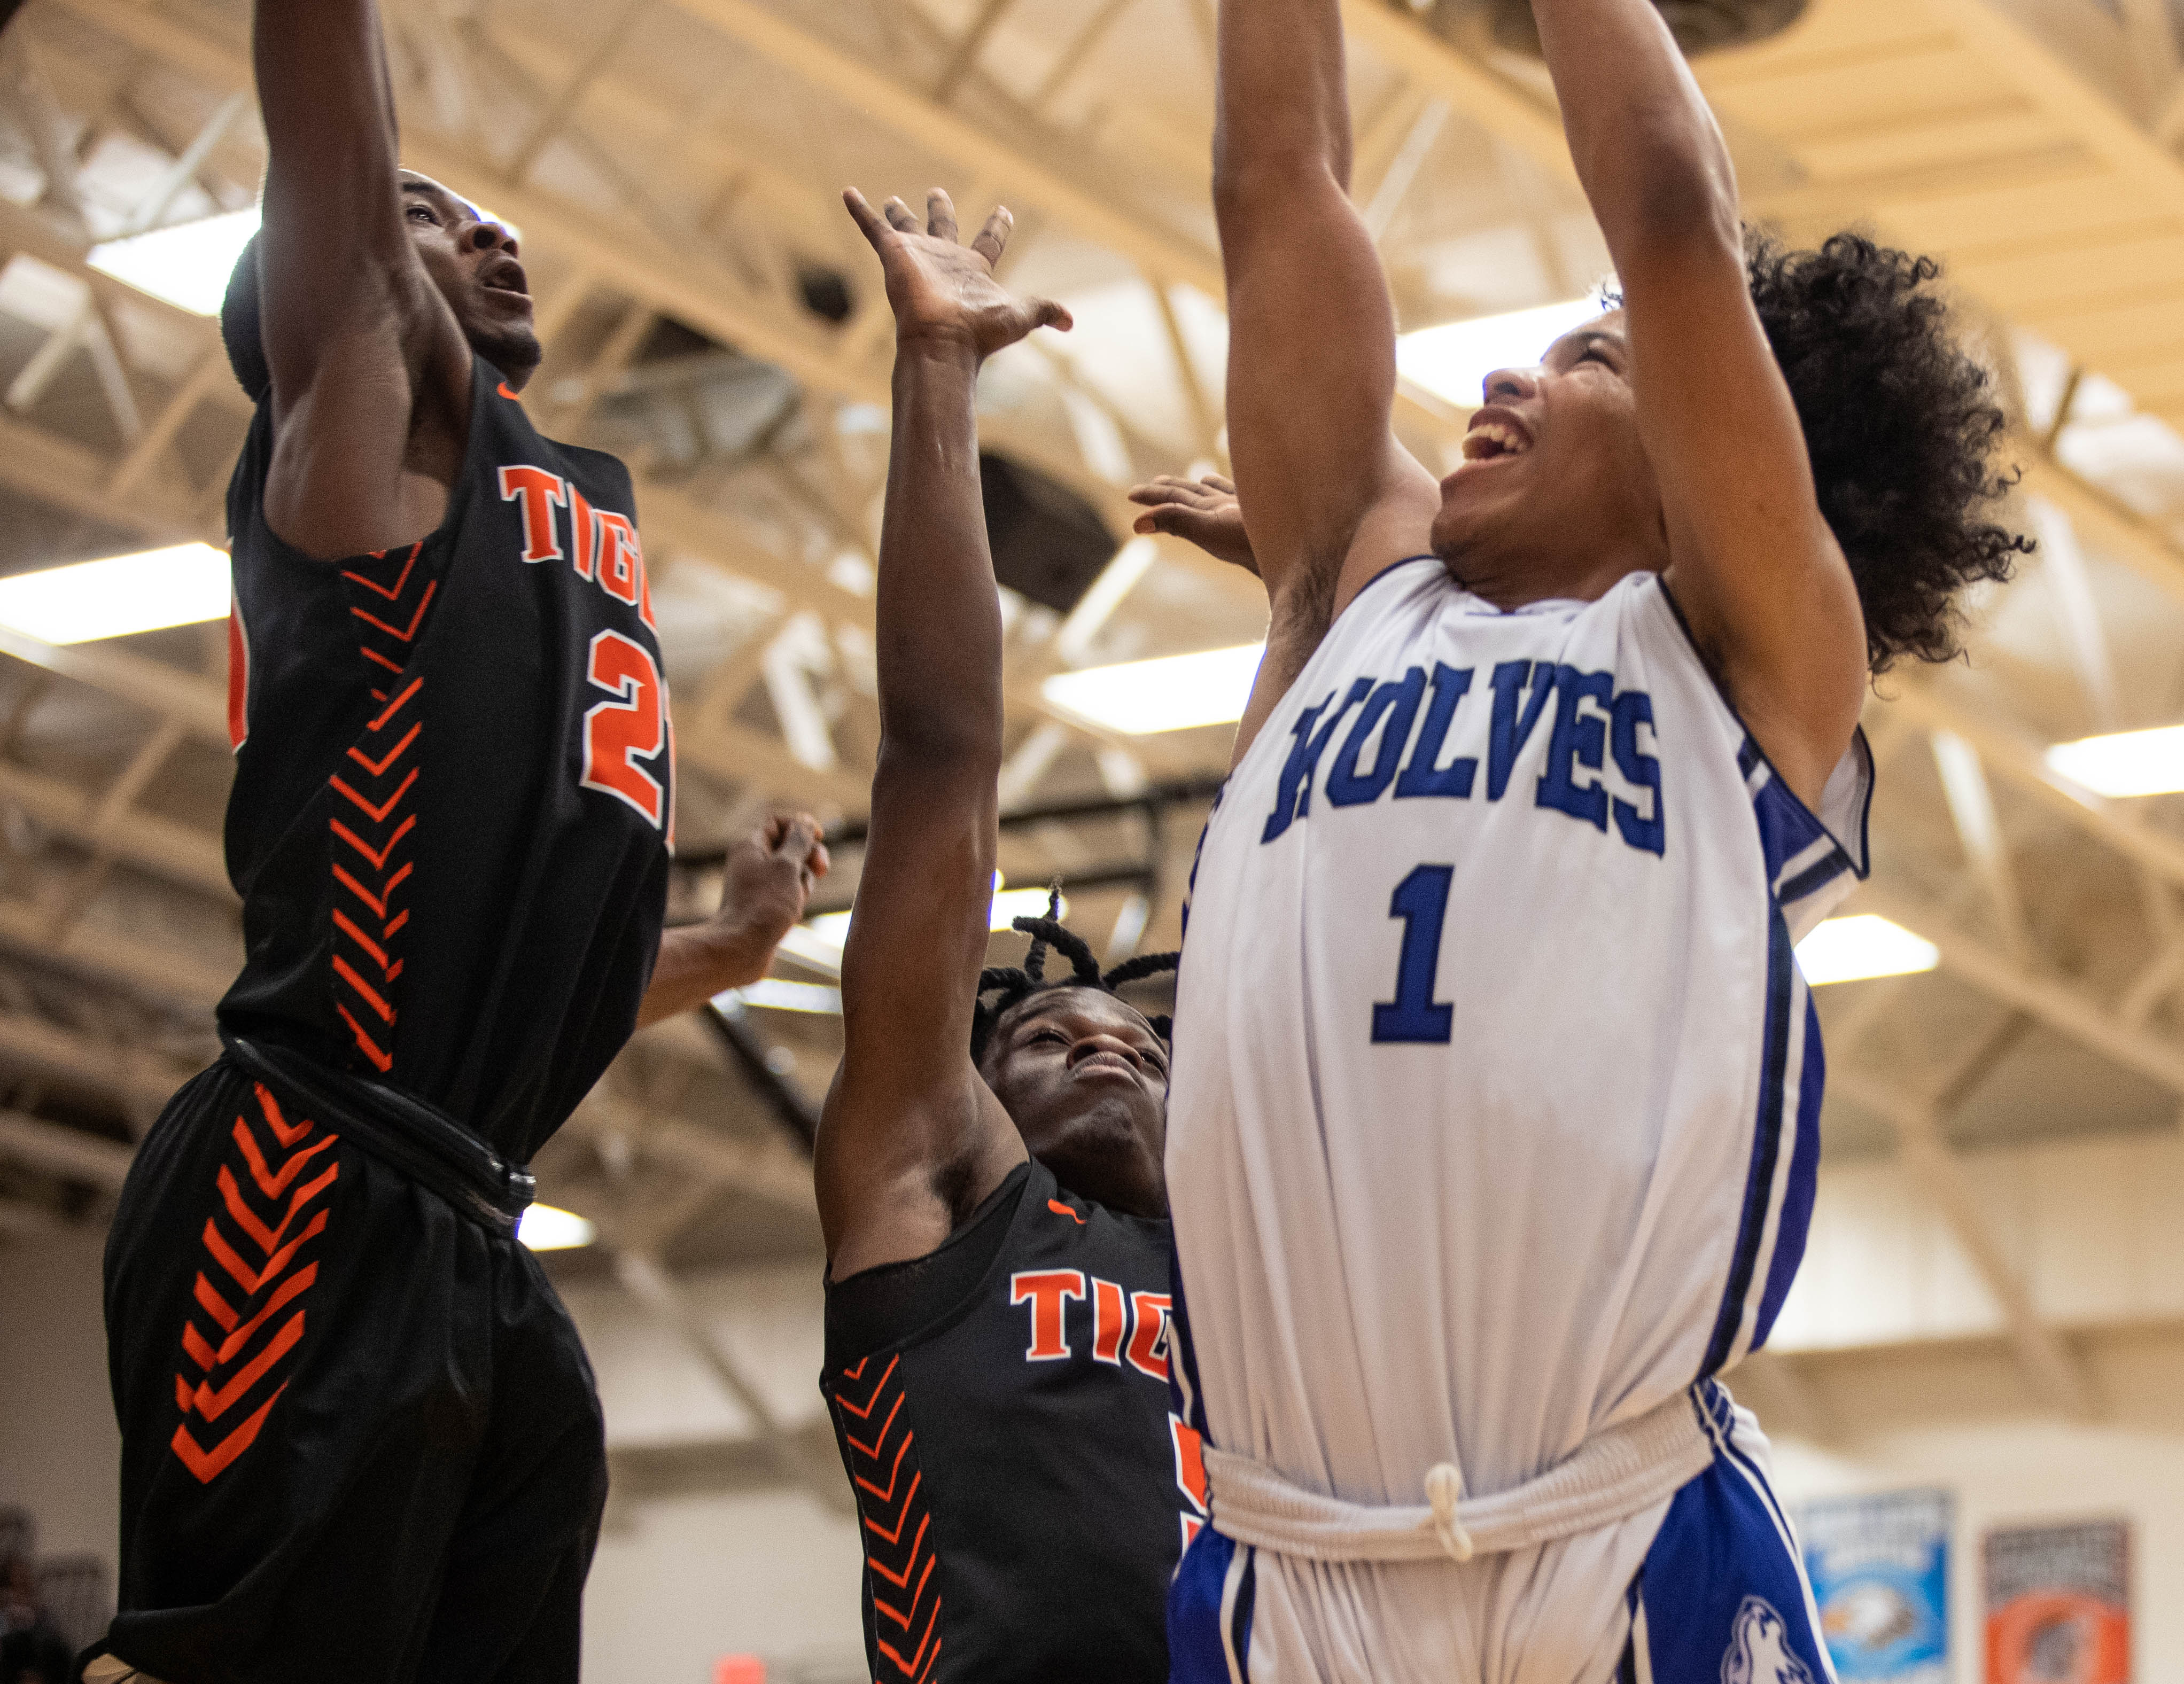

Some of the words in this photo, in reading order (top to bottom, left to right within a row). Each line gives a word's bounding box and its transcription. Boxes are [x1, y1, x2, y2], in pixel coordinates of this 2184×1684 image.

[579, 628, 677, 857] 2
[1259, 659, 1666, 860] WOLVES
[1370, 862, 1455, 1044] 1
